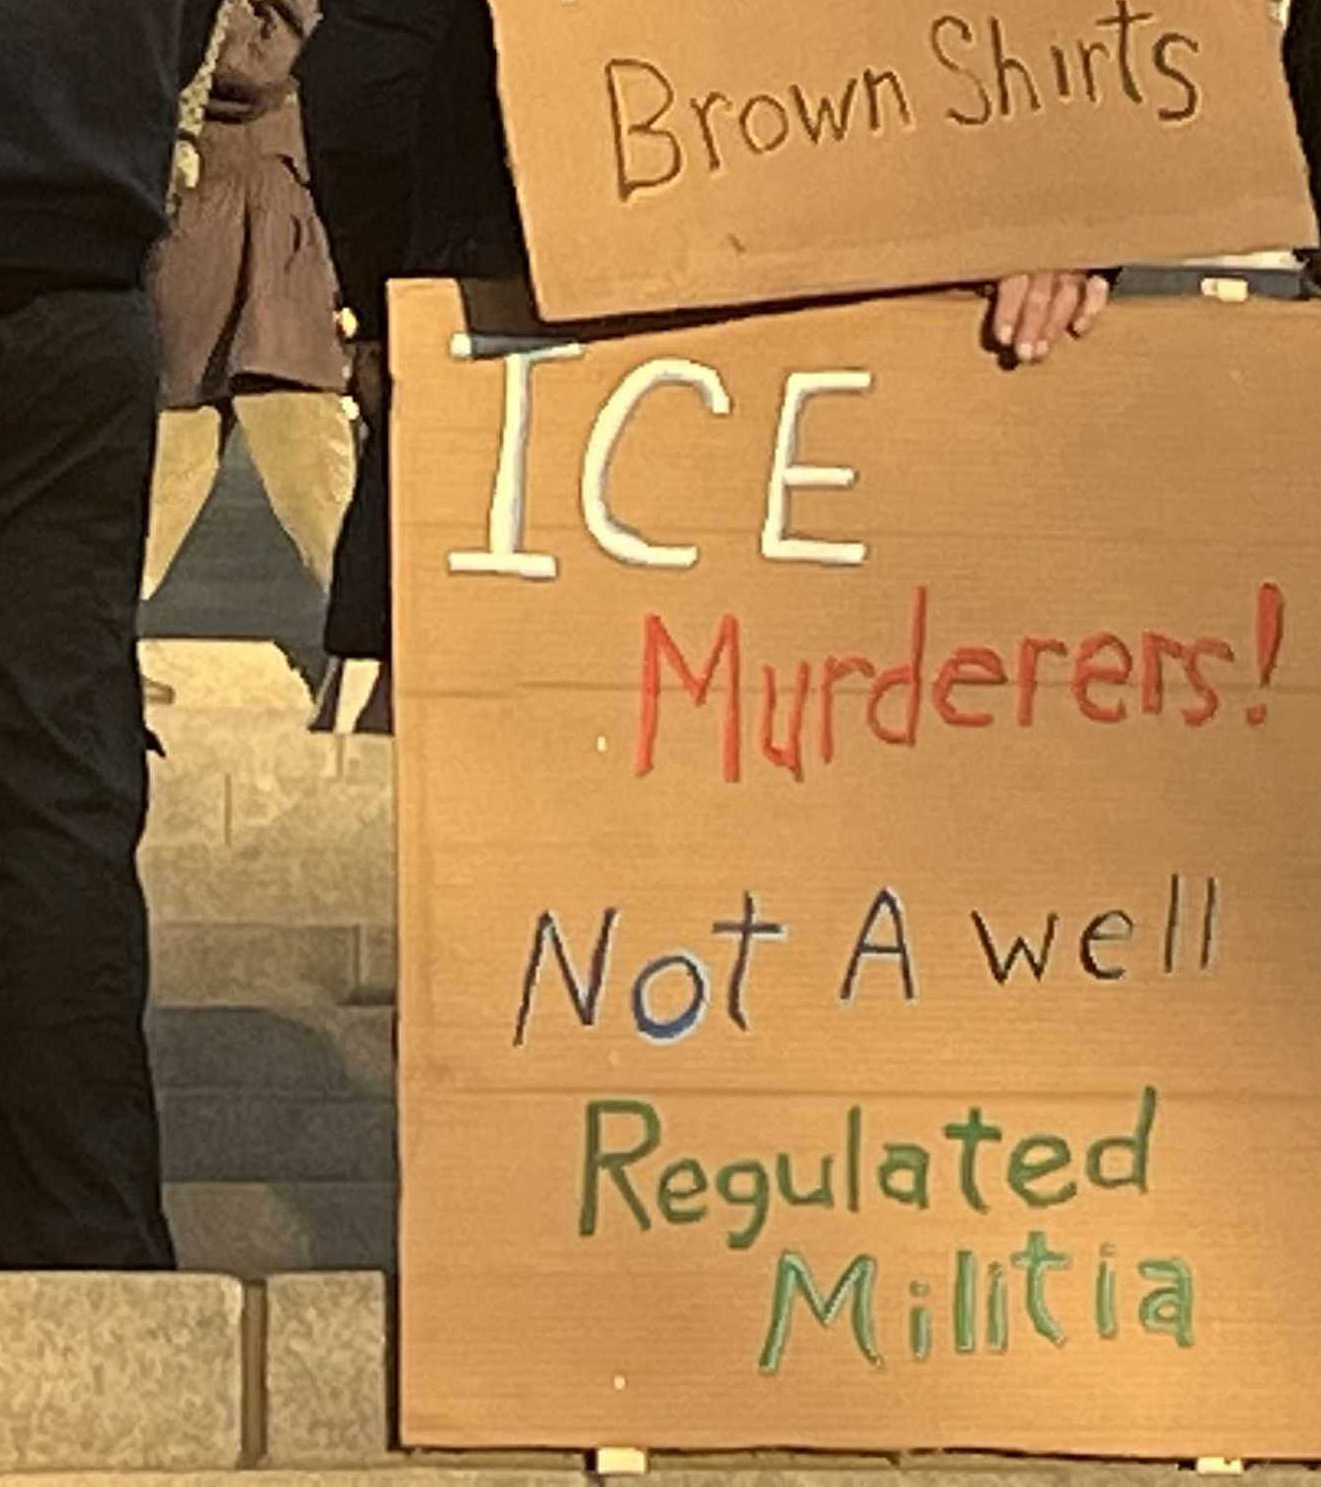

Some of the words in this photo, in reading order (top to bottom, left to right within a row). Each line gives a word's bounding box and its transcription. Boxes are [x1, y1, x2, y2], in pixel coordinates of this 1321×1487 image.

[603, 55, 913, 204] Brown
[447, 331, 875, 581] ICE
[632, 581, 1286, 784] Murderers!
[510, 889, 786, 1049] Not
[839, 886, 918, 1005] A
[970, 872, 1219, 983] well
[577, 1085, 1158, 1251] Regulated
[757, 1229, 1195, 1374] Militia
